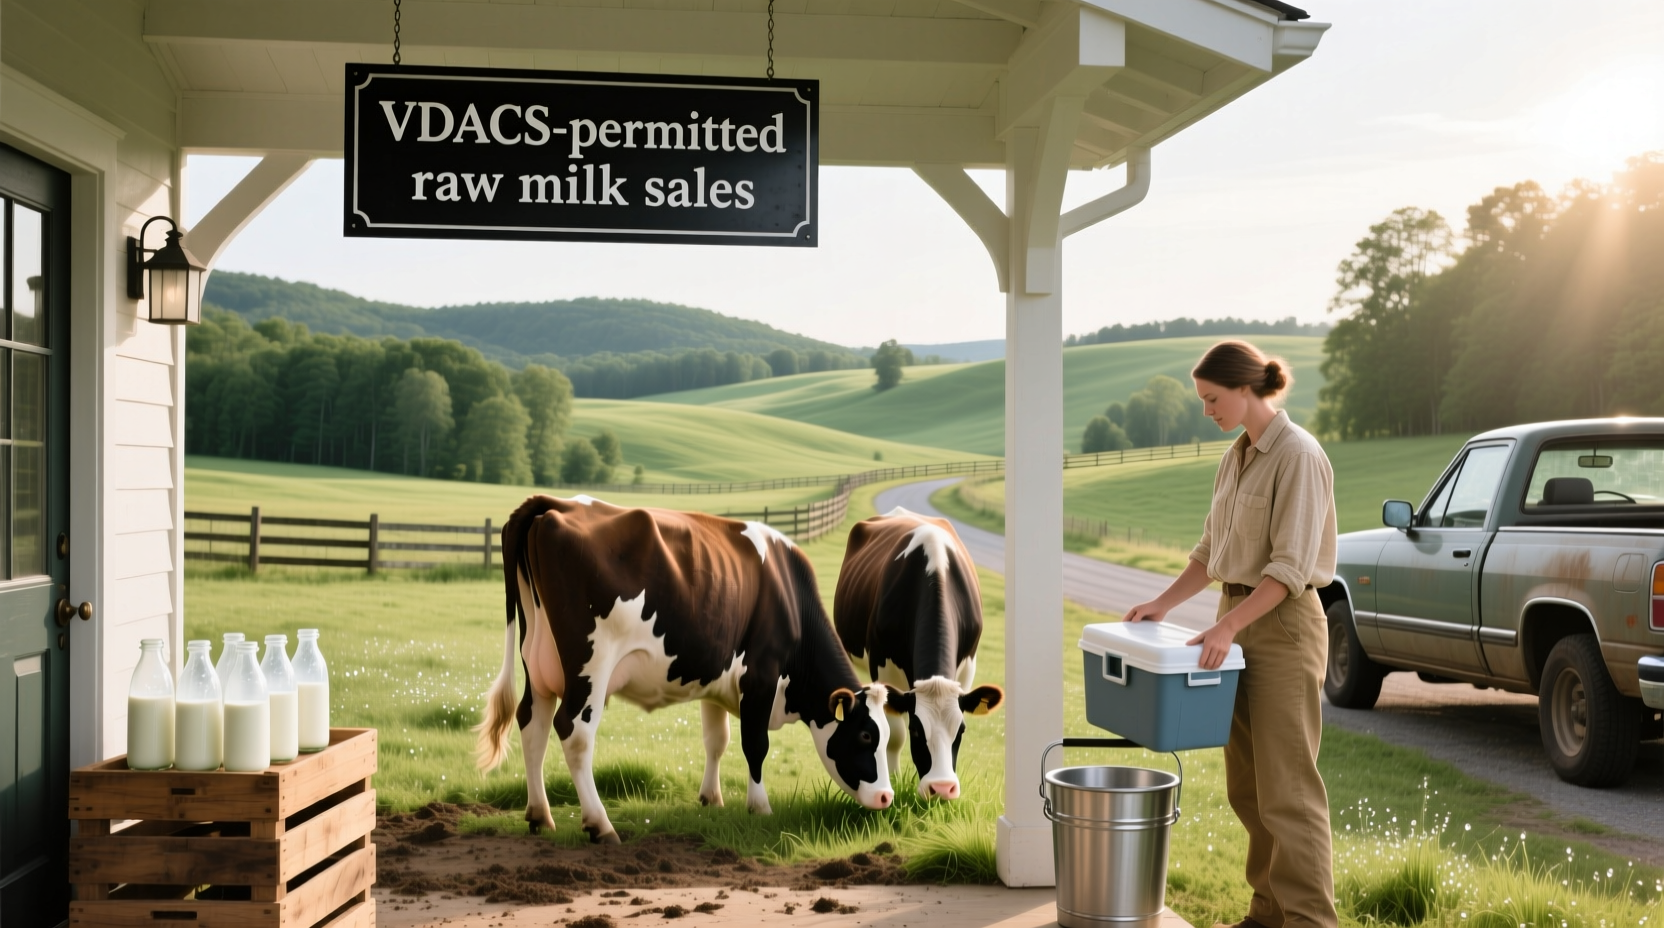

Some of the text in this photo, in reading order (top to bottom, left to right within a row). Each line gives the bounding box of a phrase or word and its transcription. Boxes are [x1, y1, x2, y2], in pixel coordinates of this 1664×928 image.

[378, 100, 787, 159] VDACS-permitted
[411, 163, 756, 210] raw milk sales
